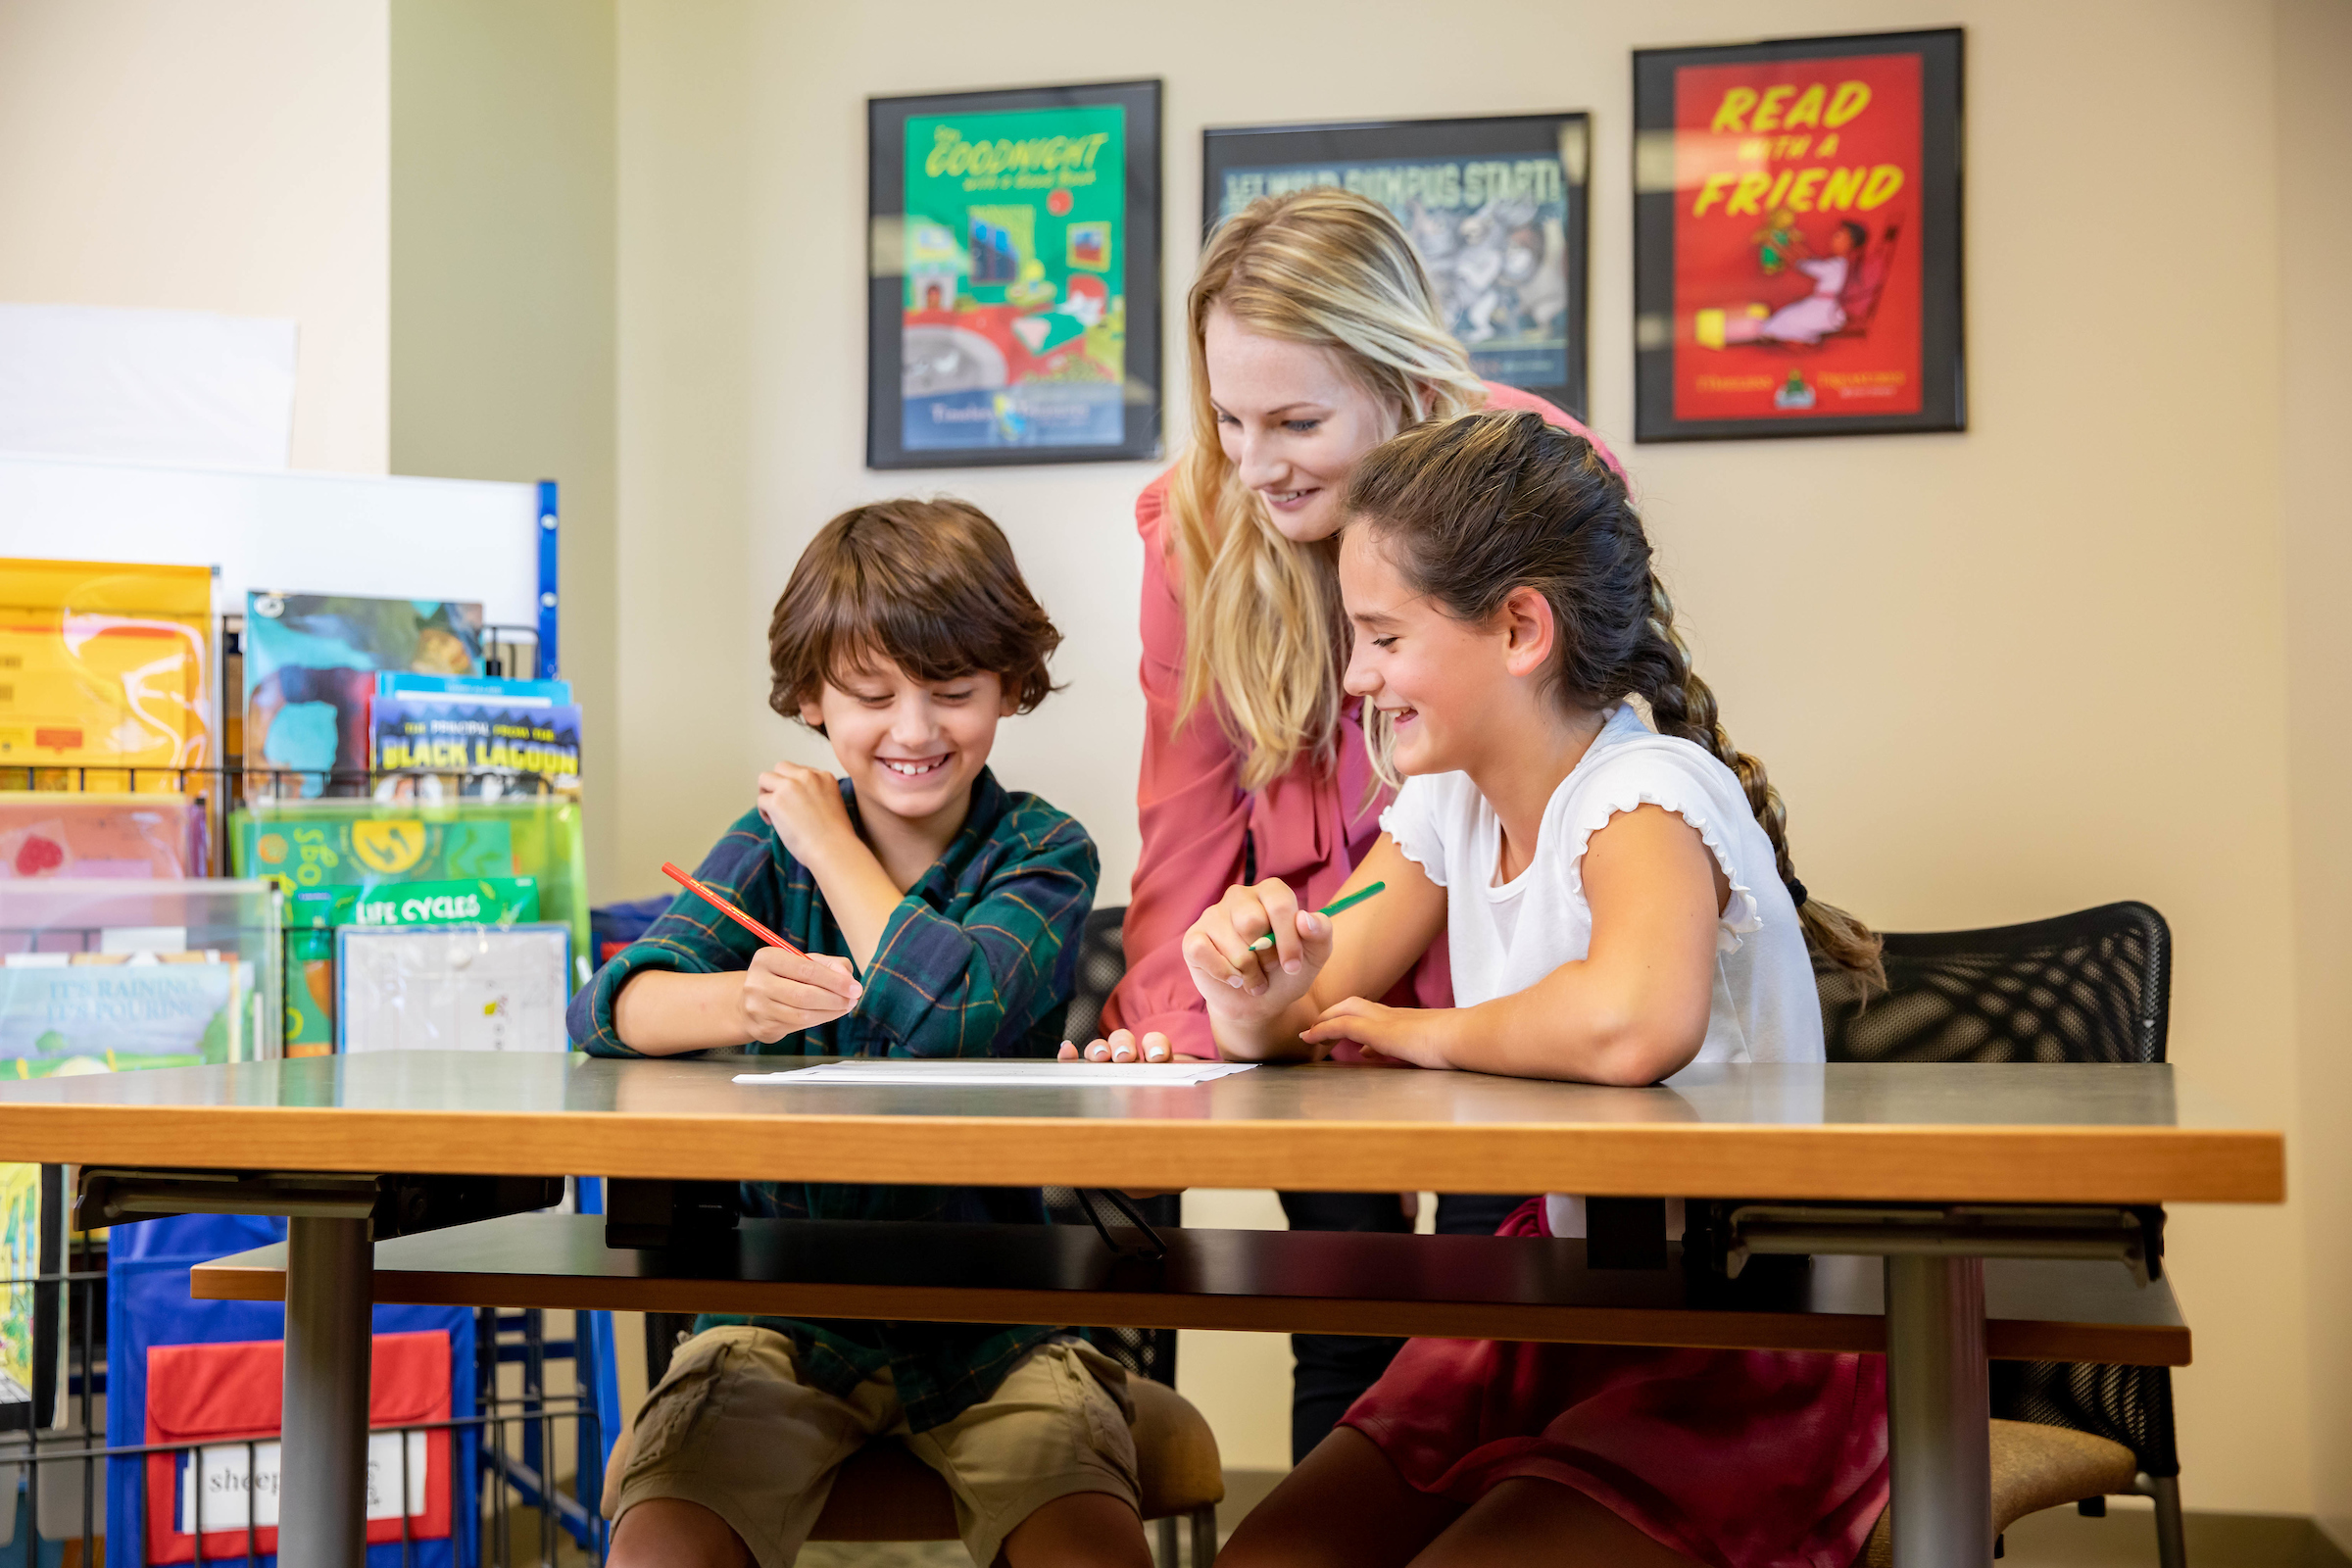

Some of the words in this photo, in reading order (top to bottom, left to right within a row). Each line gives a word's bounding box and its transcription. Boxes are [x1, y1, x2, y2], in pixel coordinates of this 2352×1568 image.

[1711, 80, 1872, 132] READ
[925, 132, 1109, 177] GOODNIGHT
[1815, 132, 1840, 159] A
[1692, 163, 1905, 218] FRIEND
[382, 736, 469, 770] BLACK
[475, 736, 579, 776] LAGOON
[356, 901, 399, 924] LIFE
[401, 894, 480, 921] CYCLES
